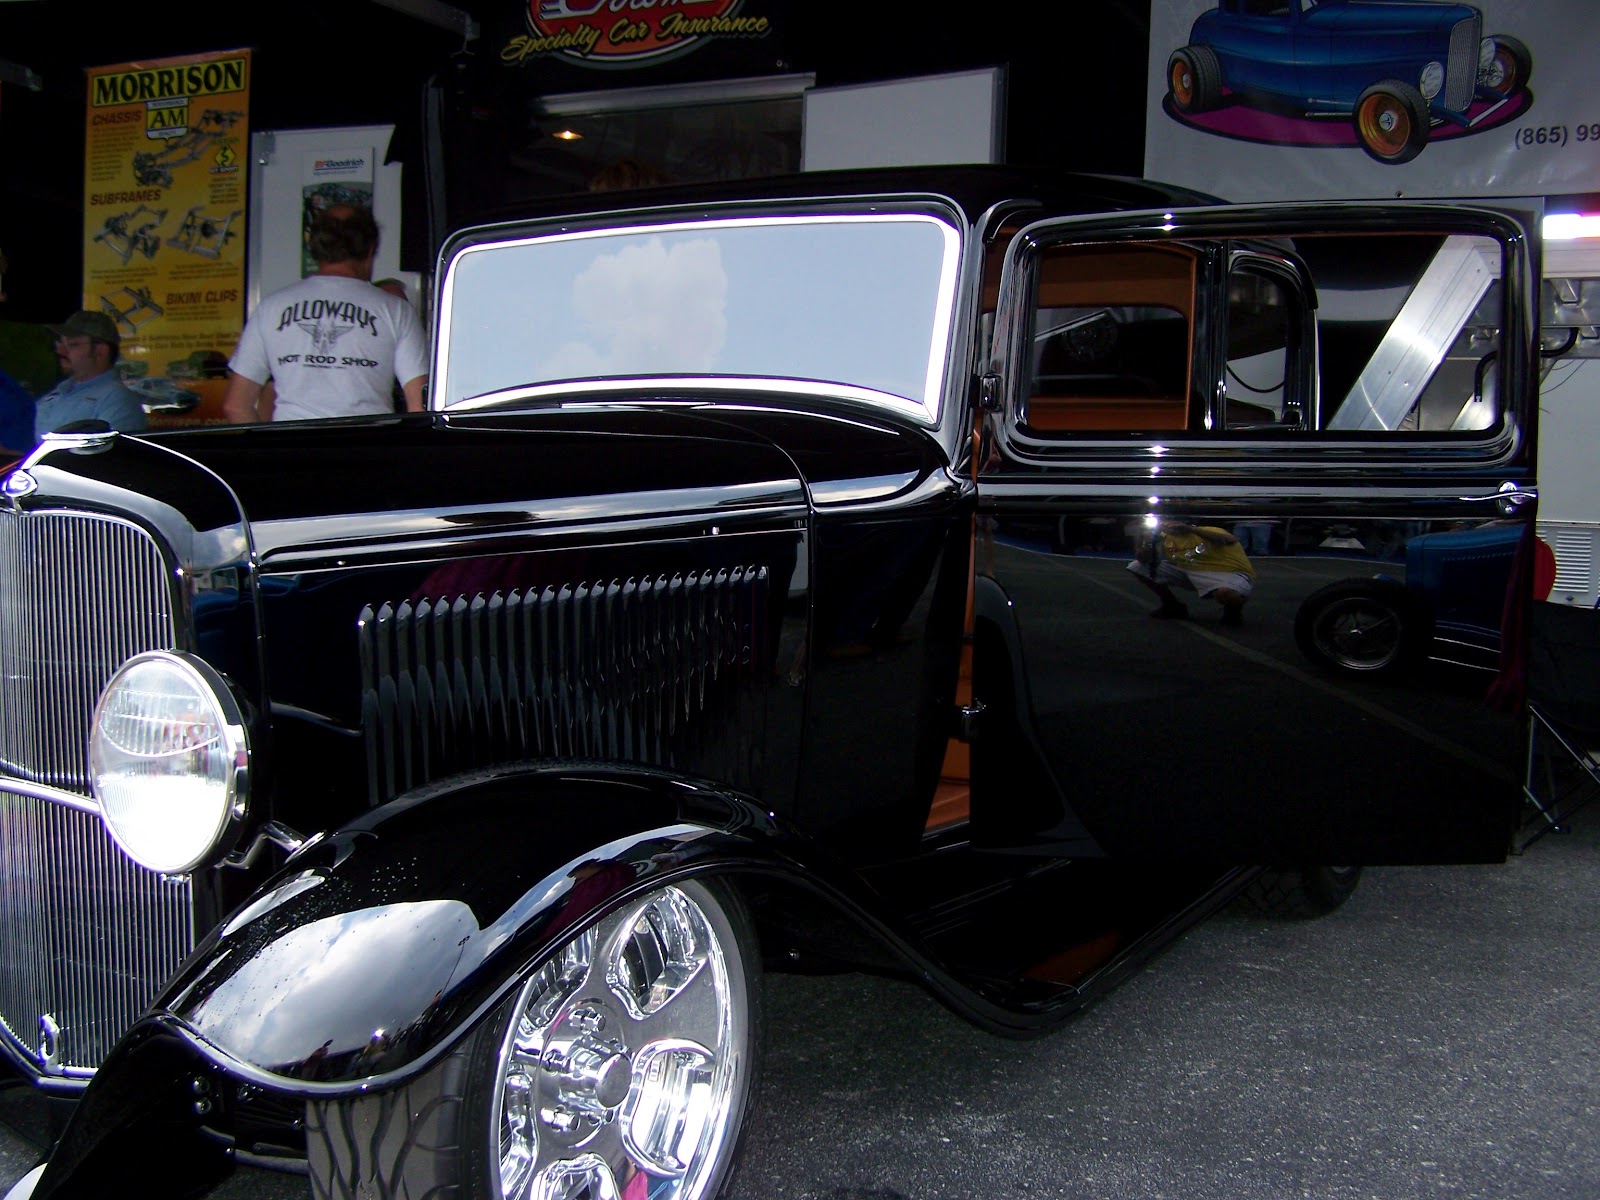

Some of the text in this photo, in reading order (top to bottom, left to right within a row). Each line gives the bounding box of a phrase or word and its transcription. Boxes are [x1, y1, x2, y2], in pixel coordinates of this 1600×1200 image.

[501, 12, 770, 60] Specialty Car Insurance
[95, 61, 244, 105] MORRISON
[92, 110, 142, 126] CHASSIS
[151, 109, 185, 128] AM
[1515, 124, 1600, 150] (865) 99
[314, 158, 364, 168] BFGoodrich
[91, 189, 161, 206] SUBFRAMES
[166, 289, 238, 305] BIKINI CLIPS
[277, 299, 378, 337] ALLOWAYS
[277, 354, 301, 366] HOT
[304, 354, 336, 365] ROD
[341, 356, 379, 369] SHOP
